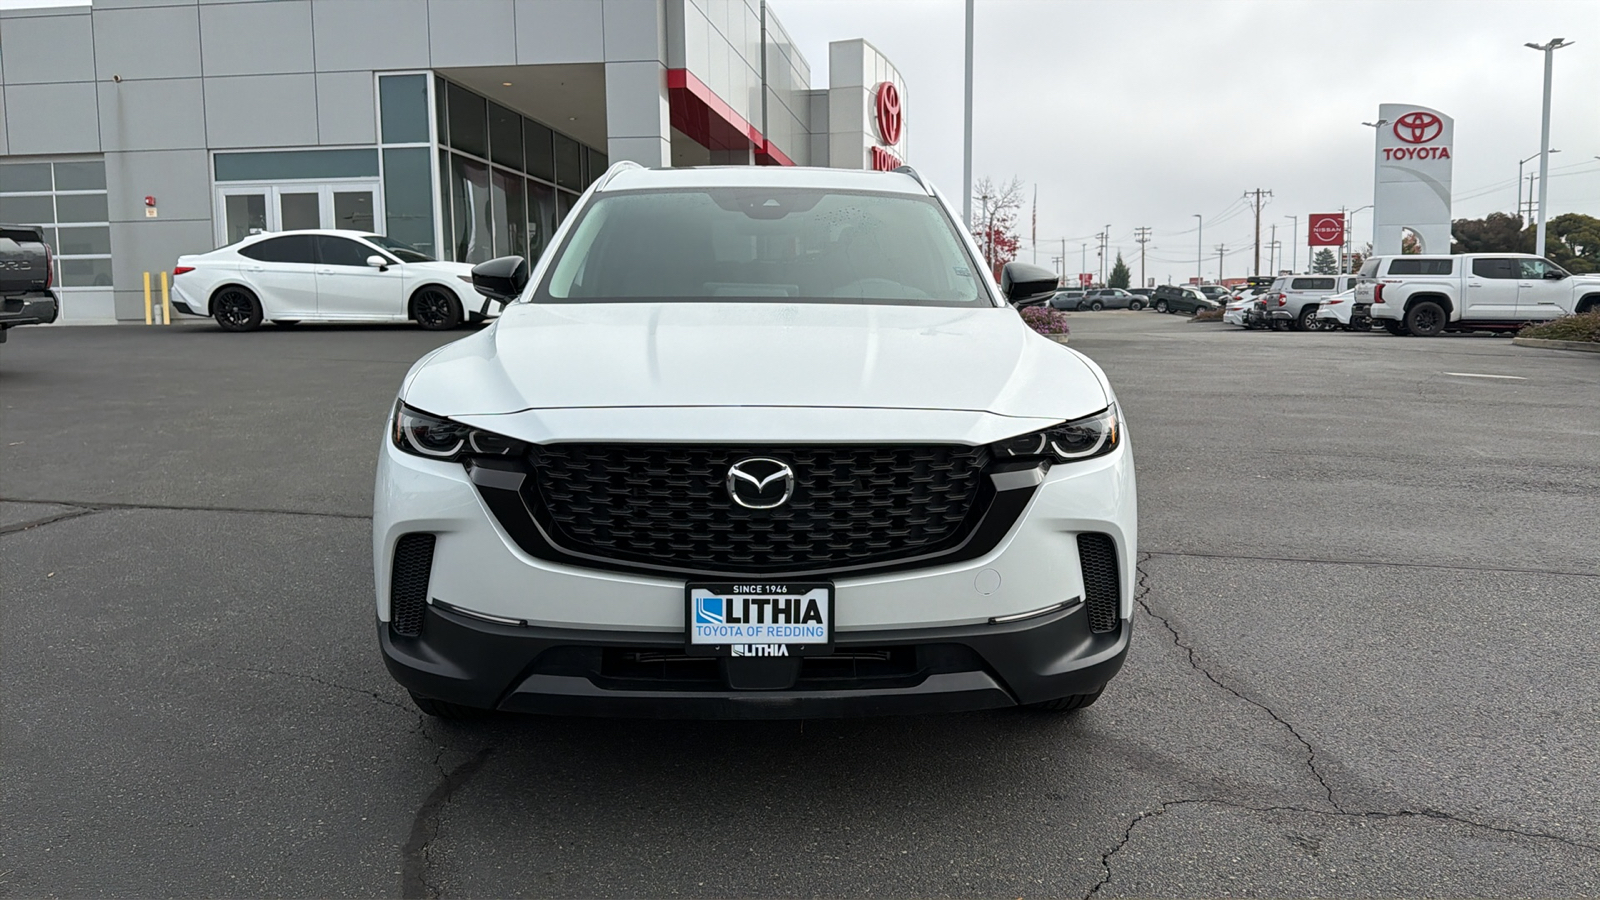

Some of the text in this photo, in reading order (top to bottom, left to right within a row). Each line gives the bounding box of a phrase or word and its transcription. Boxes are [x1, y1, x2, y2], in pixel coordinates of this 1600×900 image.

[1383, 147, 1450, 161] TOYOTA
[733, 585, 787, 593] SINCE 1946
[726, 598, 823, 624] LITHIA
[696, 626, 824, 637] TOYOTA OF REDDING
[744, 644, 789, 657] LITHIA
